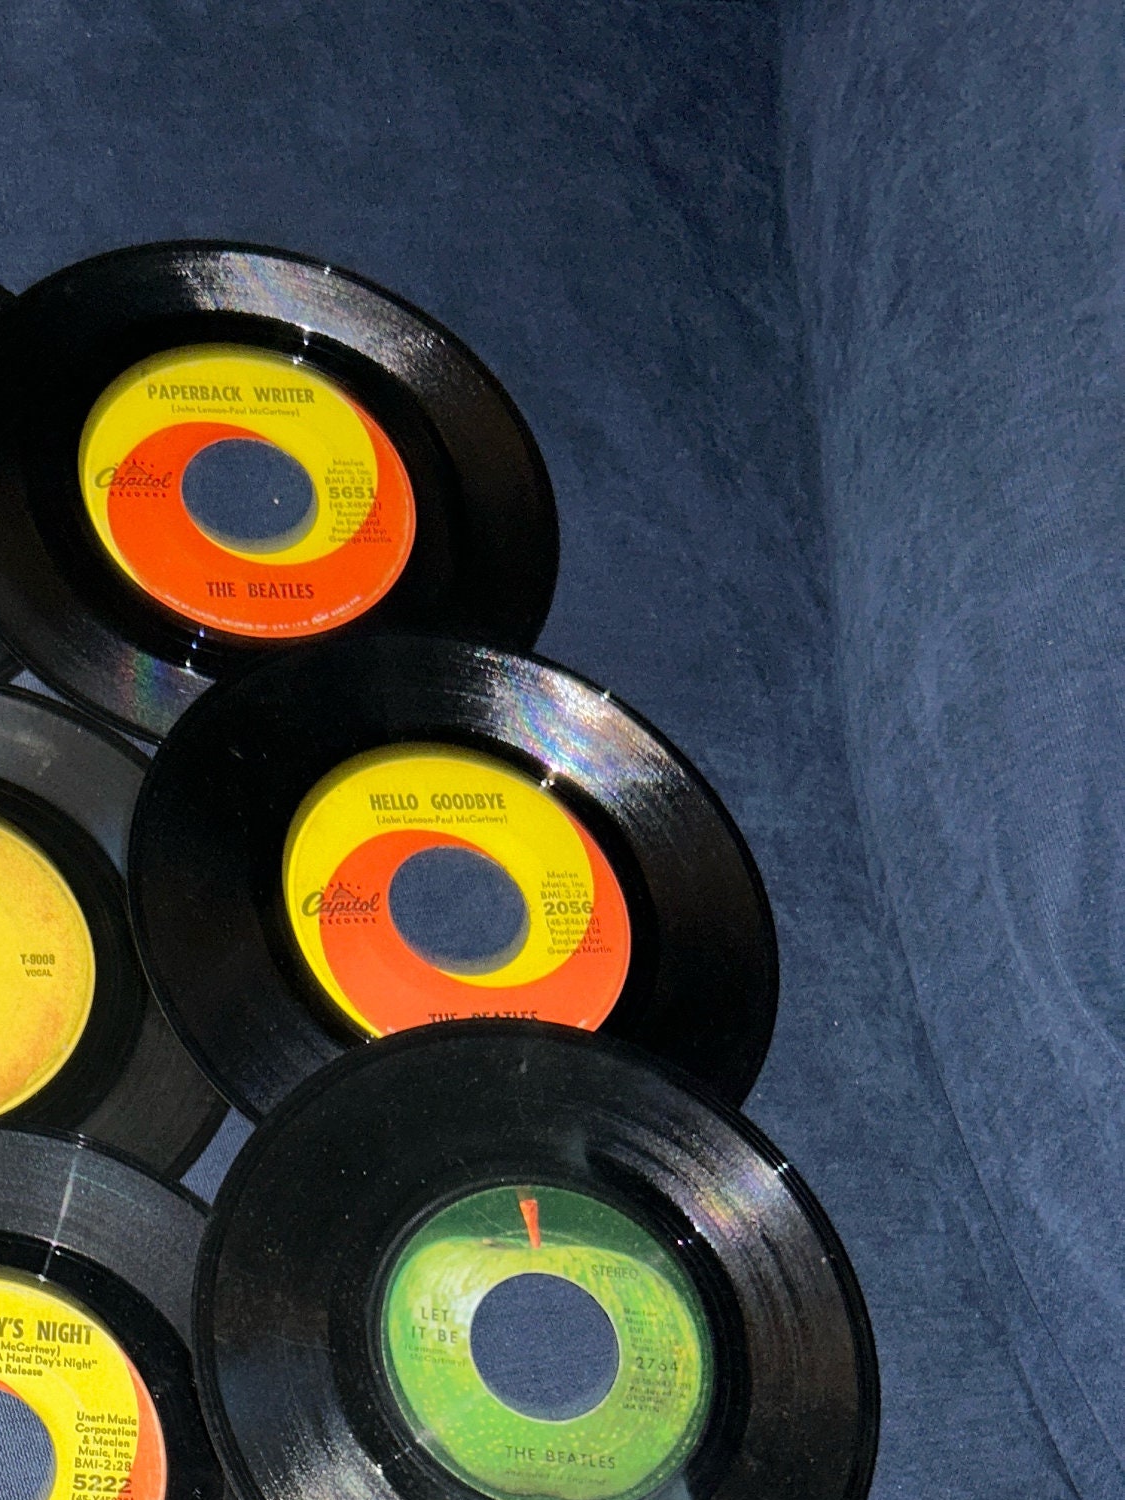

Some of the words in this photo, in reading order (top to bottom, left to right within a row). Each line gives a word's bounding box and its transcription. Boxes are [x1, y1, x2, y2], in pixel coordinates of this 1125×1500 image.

[146, 384, 243, 401] PAPERBACK
[254, 387, 316, 404] WRITER
[95, 467, 173, 490] Capitol
[329, 486, 377, 500] 5651
[206, 582, 236, 598] THE
[248, 582, 315, 599] BEATLES
[369, 793, 419, 811] HELLO
[430, 792, 507, 811] GOODBYE
[302, 891, 381, 917] Capitol
[543, 900, 595, 916] 2056
[20, 953, 56, 965] T-9008
[25, 968, 53, 977] VOCAL
[591, 1264, 639, 1281] STEREO
[421, 1306, 449, 1322] LET
[37, 1320, 94, 1345] NIGHT
[411, 1326, 427, 1340] IT
[438, 1329, 459, 1344] BE
[1, 1341, 62, 1357] McCartney)
[8, 1352, 34, 1366] Hard
[36, 1355, 62, 1370] Day's
[64, 1357, 98, 1372] Night"
[635, 1356, 678, 1372] 2764
[5, 1365, 44, 1377] Release
[76, 1411, 105, 1423] Unart
[108, 1413, 137, 1427] Music
[75, 1423, 138, 1438] Corporation
[82, 1434, 90, 1445] &
[92, 1436, 131, 1448] Maclen
[78, 1446, 111, 1459] Music,
[114, 1448, 133, 1460] Inc.
[505, 1445, 536, 1461] THE
[546, 1450, 615, 1469] BEATLES
[74, 1457, 132, 1473] BMI-2:28
[72, 1473, 132, 1493] 5222
